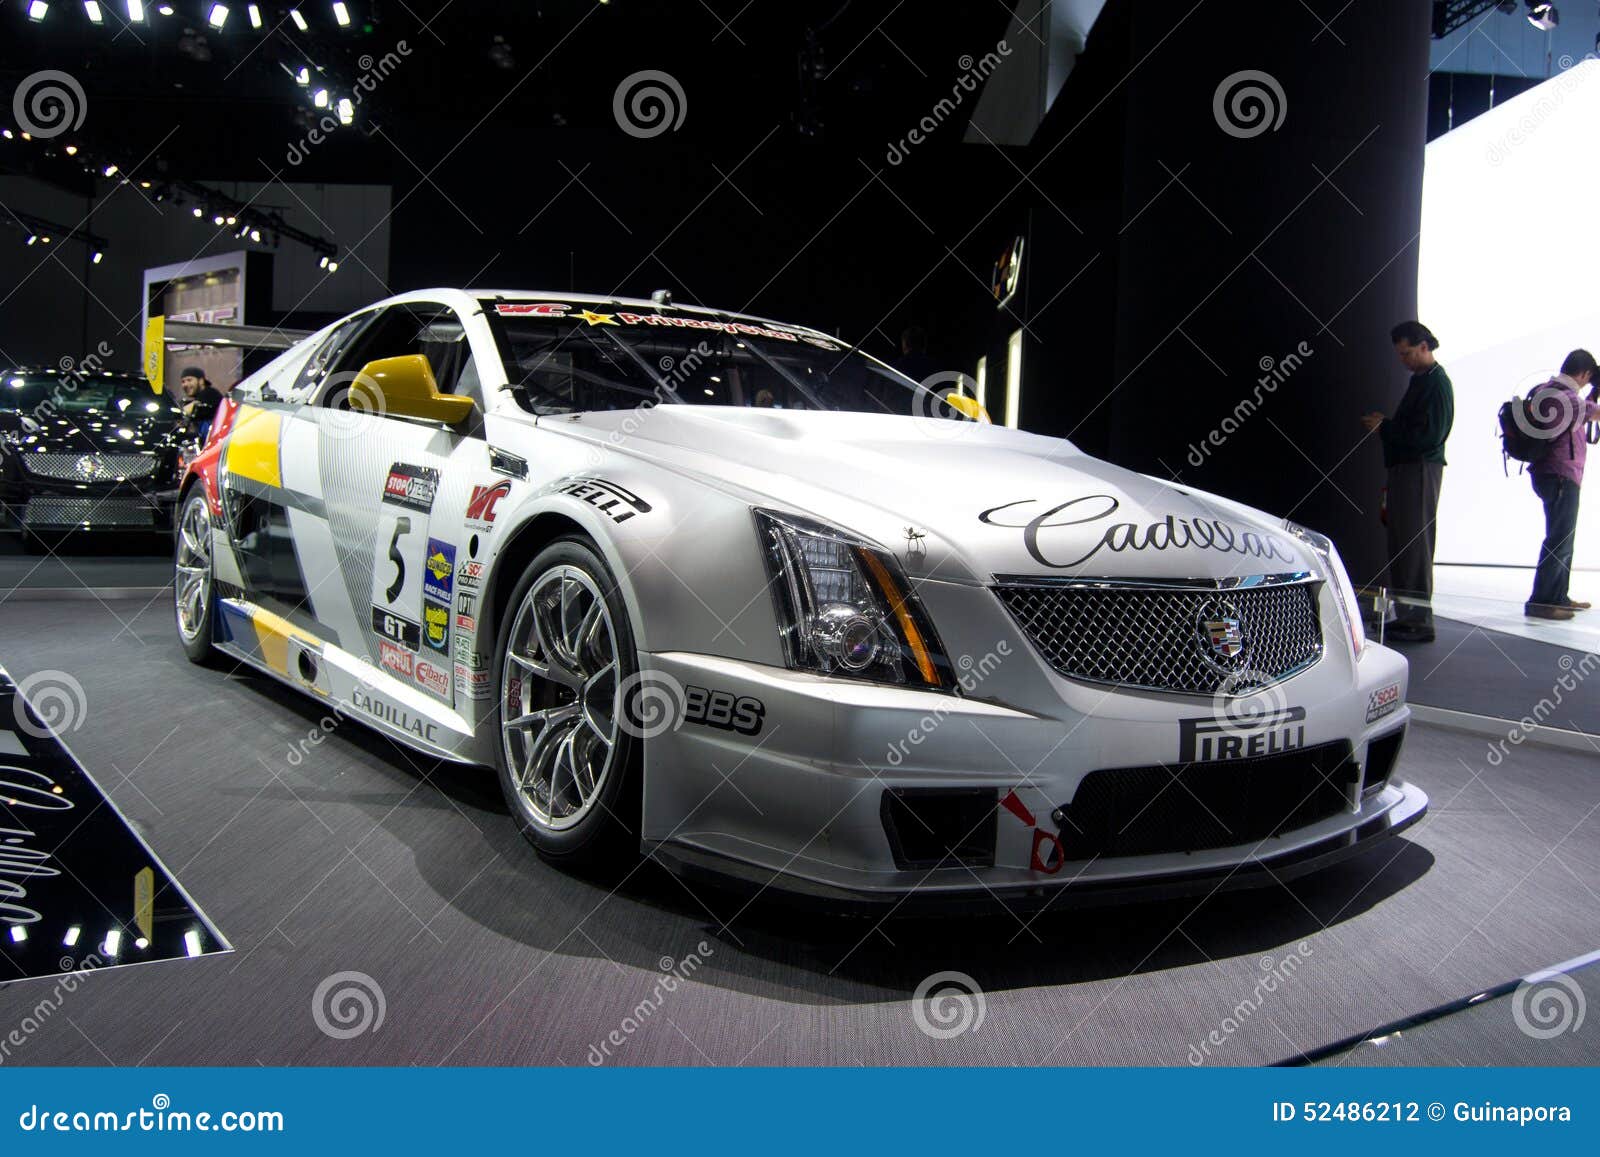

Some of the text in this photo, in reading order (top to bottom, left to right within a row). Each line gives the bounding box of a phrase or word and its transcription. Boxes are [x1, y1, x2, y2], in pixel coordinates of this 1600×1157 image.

[616, 311, 798, 343] PrivacyStar
[465, 479, 512, 522] WC
[978, 494, 1296, 569] Cadillac
[386, 516, 411, 605] 5
[427, 556, 452, 576] SUNOCO
[424, 583, 439, 596] RACE
[383, 615, 407, 641] GT
[415, 661, 449, 685] Eibach
[352, 691, 438, 743] CADILLAC
[684, 685, 766, 737] BBS
[1178, 706, 1306, 763] PIRELLI
